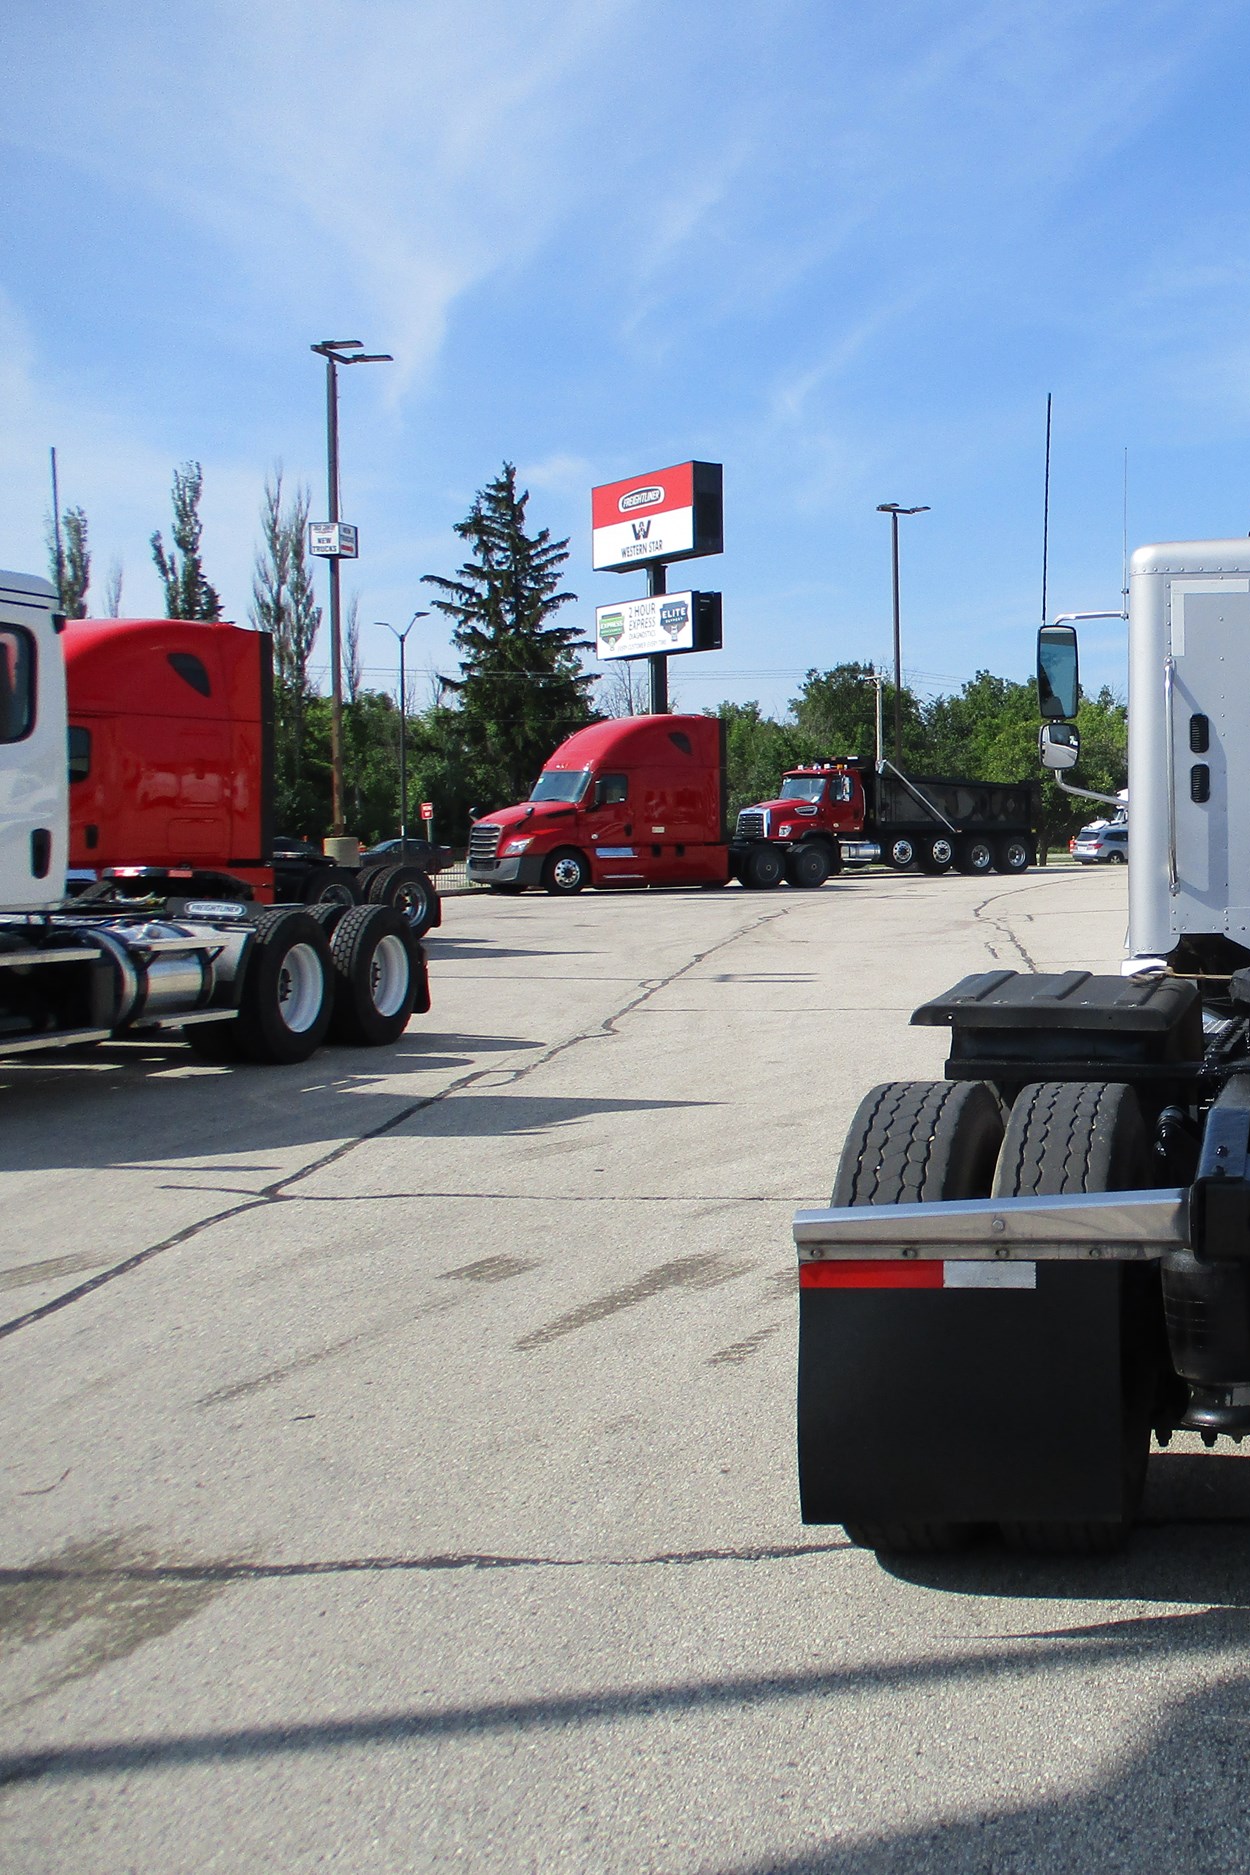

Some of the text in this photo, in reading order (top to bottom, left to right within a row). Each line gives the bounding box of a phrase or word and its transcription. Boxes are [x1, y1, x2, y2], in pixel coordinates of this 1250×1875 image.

[623, 490, 660, 508] FREIGHTLINER
[312, 545, 337, 553] TRUCKS
[621, 540, 663, 558] WESTERN STAR
[629, 602, 656, 618] 2 HOUR
[662, 607, 686, 620] ELITE
[629, 616, 656, 631] EXPRESS
[629, 630, 656, 640] DIAGNOSTICS
[191, 904, 240, 913] FREIGHTLINER
